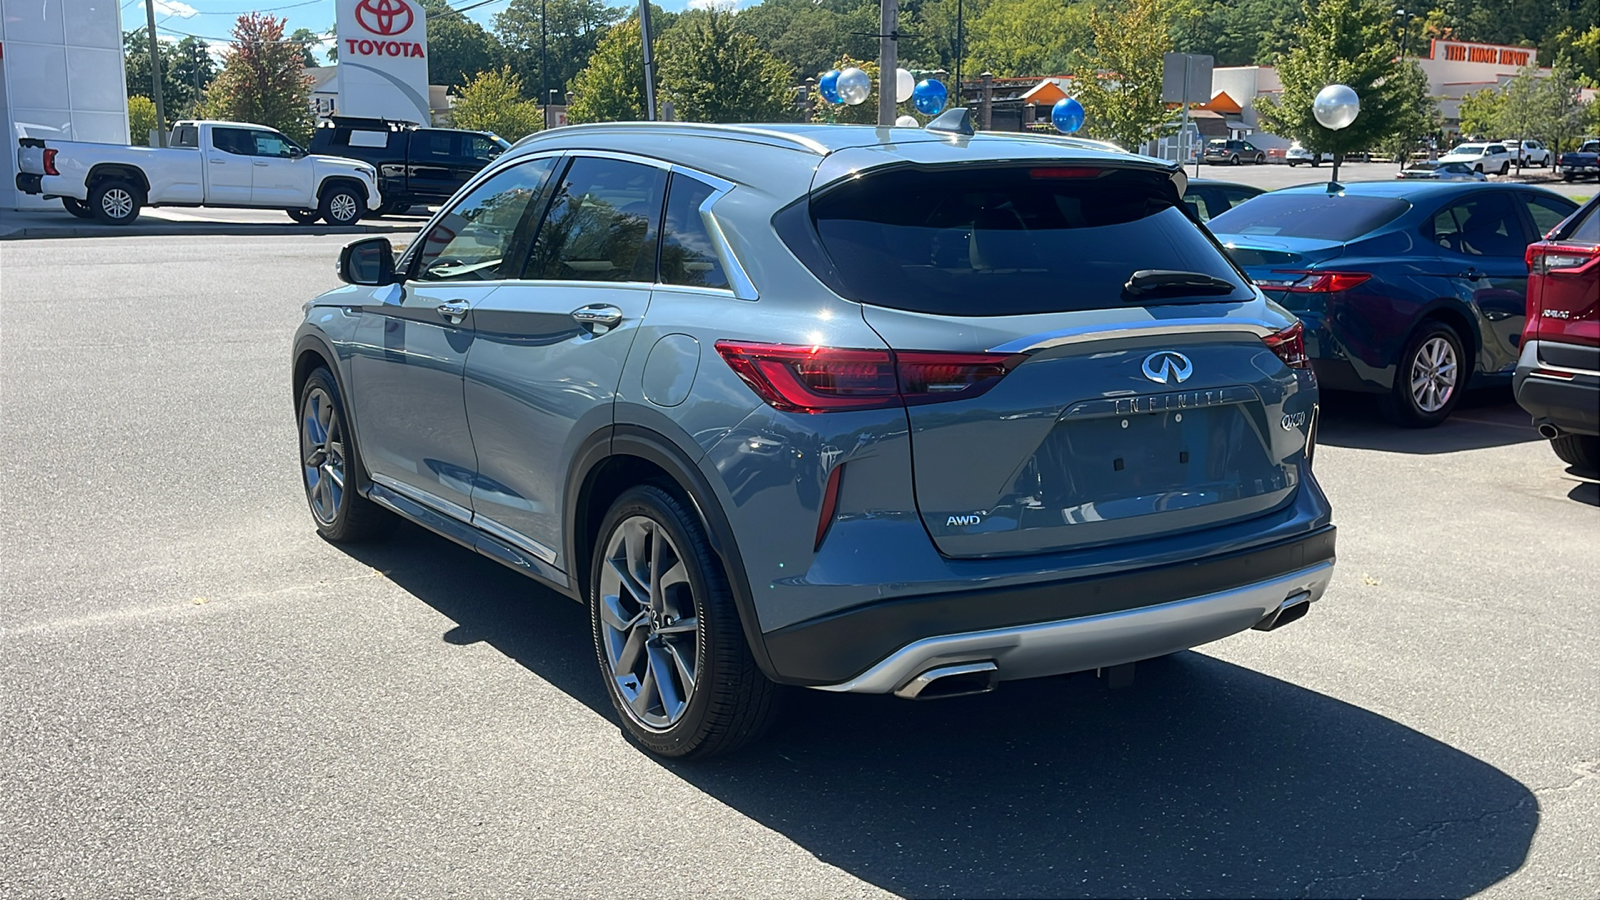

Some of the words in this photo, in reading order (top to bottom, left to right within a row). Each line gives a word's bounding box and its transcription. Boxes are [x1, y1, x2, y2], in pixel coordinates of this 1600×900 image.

[345, 39, 425, 58] TOYOTA
[1445, 44, 1466, 61] THE
[1467, 46, 1497, 64] HOME
[1498, 48, 1530, 66] DEPOT
[1115, 390, 1224, 415] INFINITI
[1281, 411, 1306, 431] QX50
[946, 515, 981, 526] AWD
